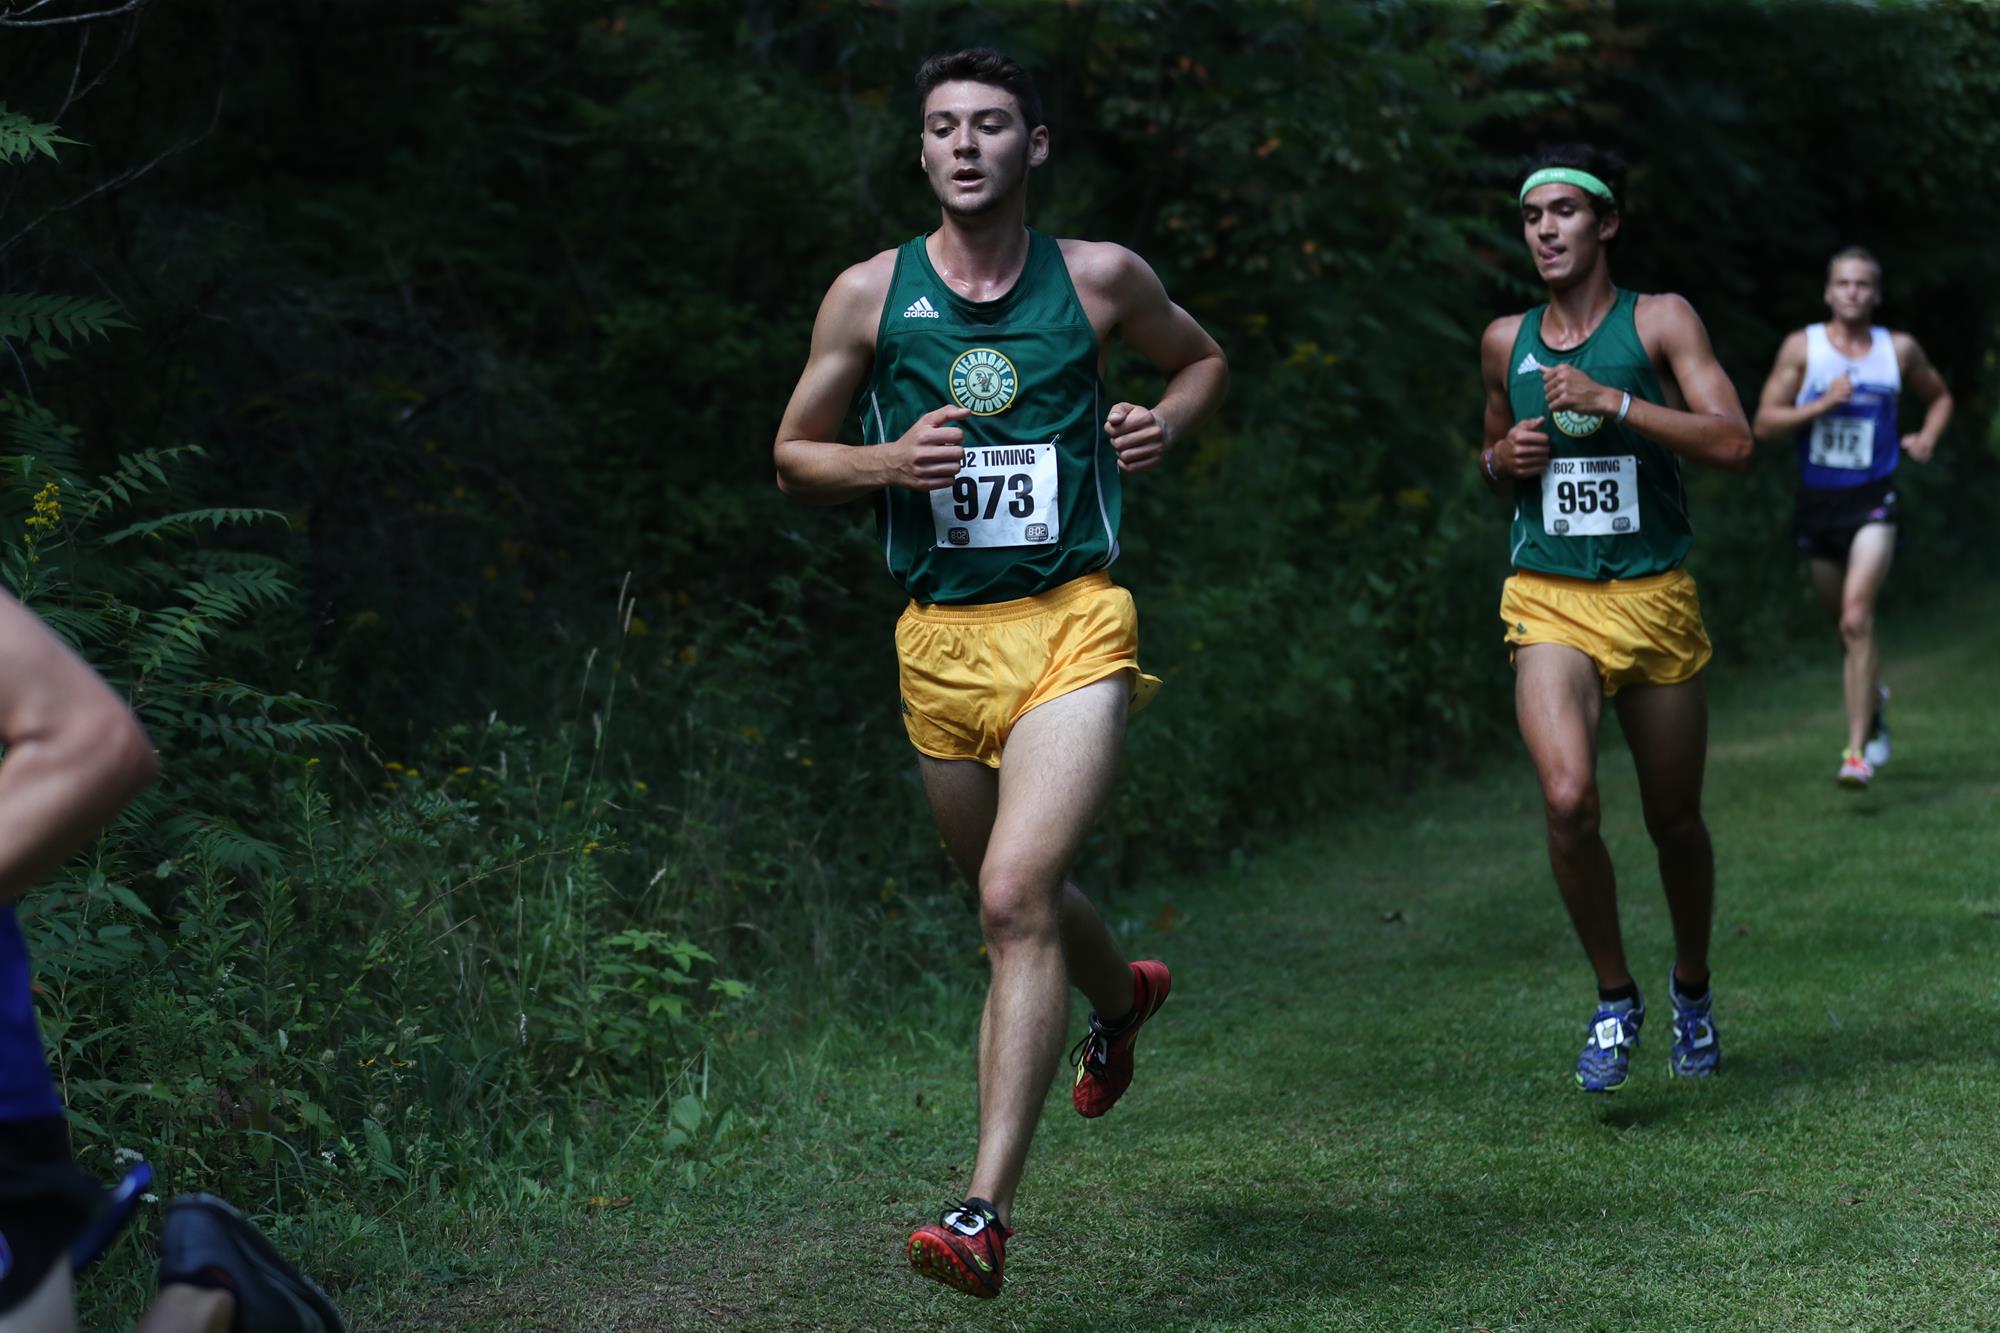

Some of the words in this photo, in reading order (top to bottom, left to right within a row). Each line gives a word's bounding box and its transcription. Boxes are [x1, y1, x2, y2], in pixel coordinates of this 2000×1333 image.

[903, 310, 940, 319] adidas
[954, 351, 1012, 376] VERMONT
[952, 378, 1015, 413] CATAMOUNTS
[981, 448, 1035, 467] TIMING
[1553, 461, 1575, 475] 802
[1580, 459, 1621, 474] TIMING
[952, 473, 1035, 522] 973
[1557, 478, 1620, 515] 953
